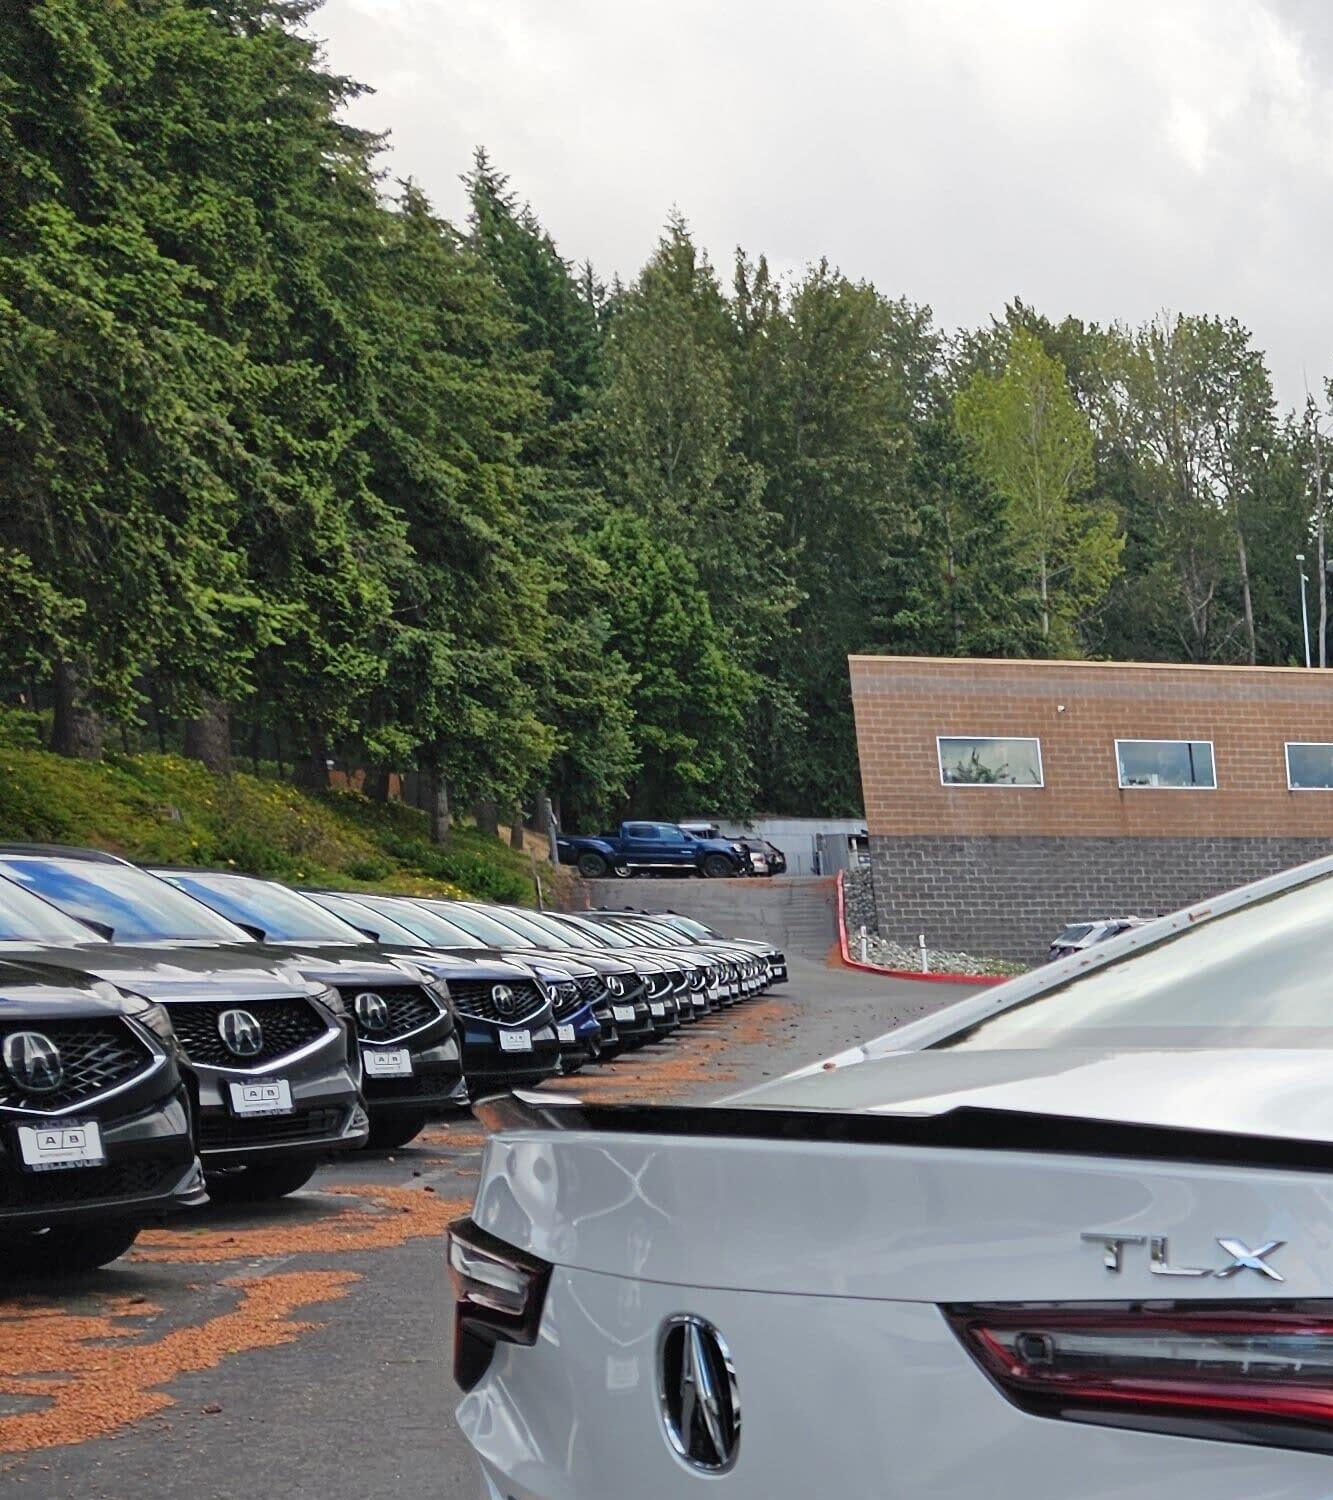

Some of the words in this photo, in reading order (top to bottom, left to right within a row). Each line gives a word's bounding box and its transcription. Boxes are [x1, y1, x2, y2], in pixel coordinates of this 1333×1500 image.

[45, 1136, 57, 1145] A
[69, 1135, 80, 1144] B
[1079, 1231, 1288, 1282] TLX
